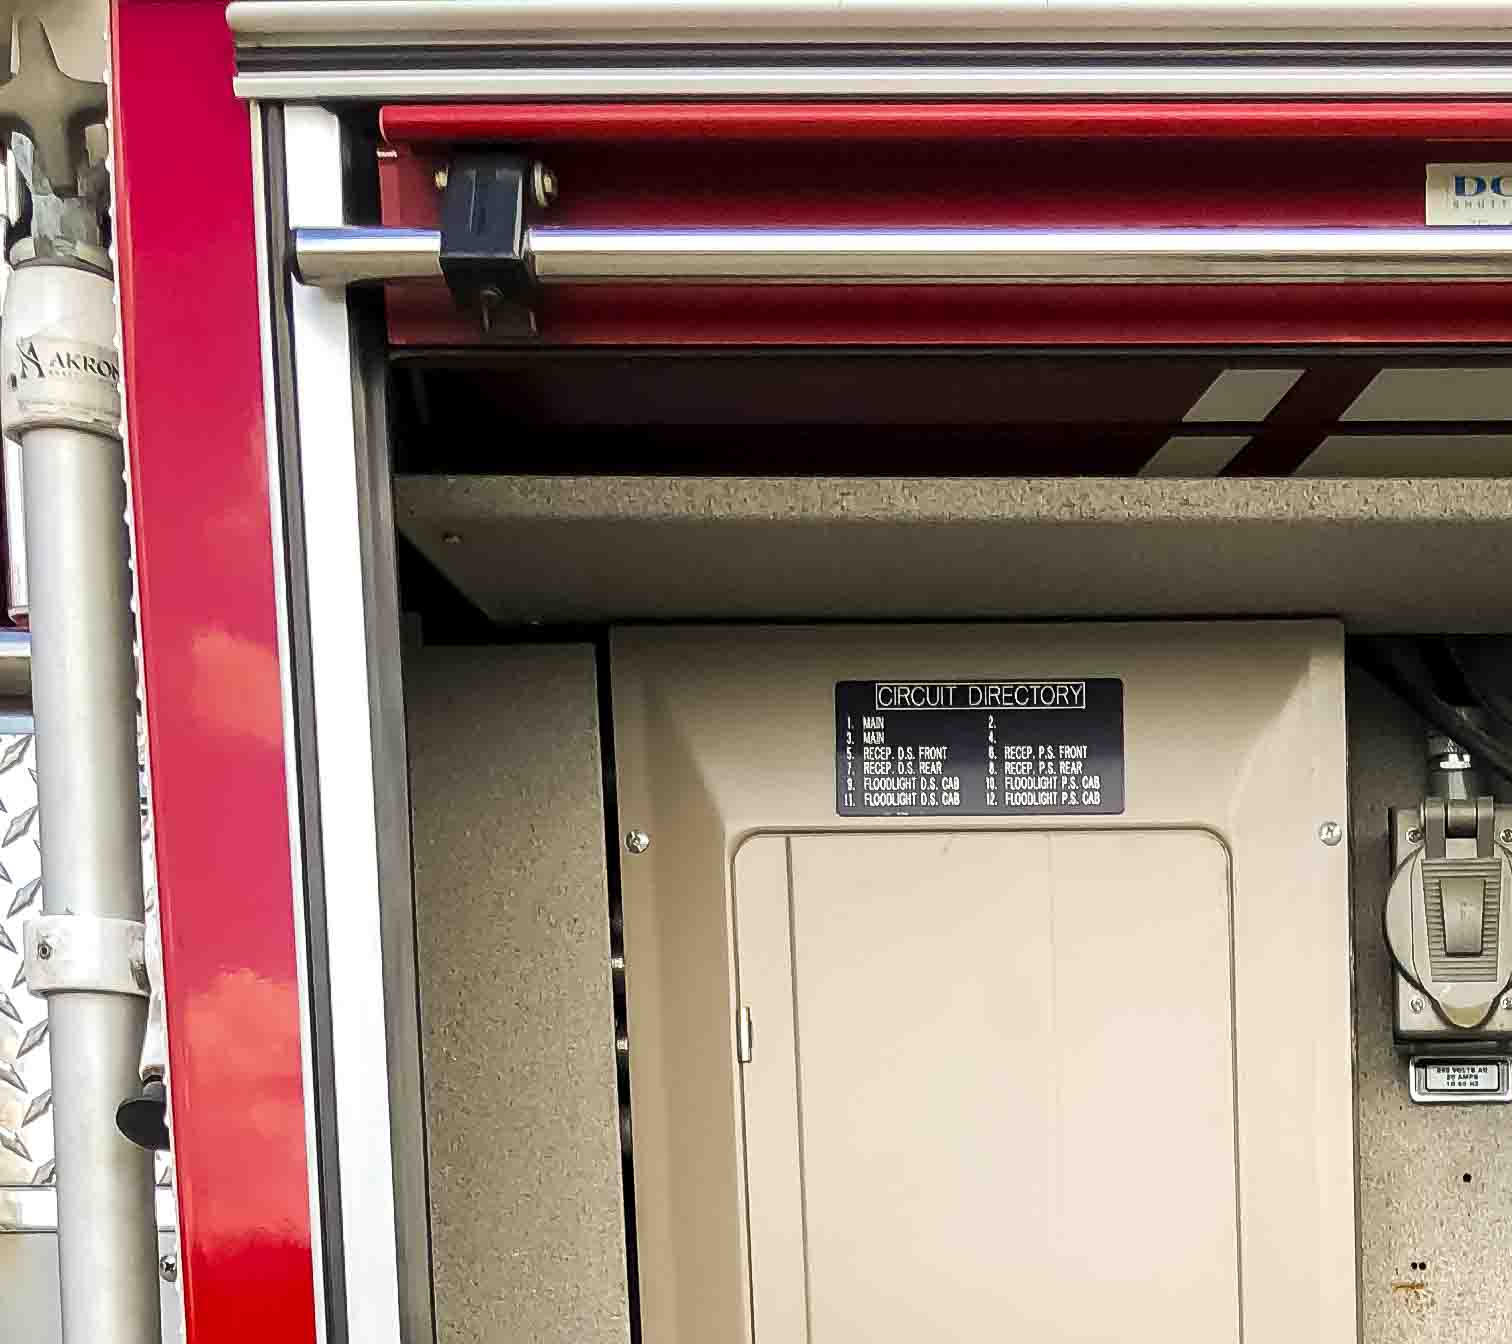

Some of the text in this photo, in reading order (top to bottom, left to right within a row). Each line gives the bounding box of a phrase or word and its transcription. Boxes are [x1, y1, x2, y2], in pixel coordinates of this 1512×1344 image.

[878, 685, 1084, 706] CIRCUIT DIRECTORY
[862, 716, 884, 730] MAIN
[988, 716, 997, 729] 2.
[846, 731, 885, 745] 3. MAIN
[863, 746, 895, 760] RECEP.
[918, 746, 948, 760] FRONT
[1004, 746, 1036, 760] RECEP.
[1038, 746, 1056, 760] P.S.
[1059, 746, 1088, 760] FRONT
[863, 761, 895, 775] RECEP.
[898, 761, 916, 775] D.S.
[919, 761, 943, 775] REAR
[1004, 761, 1036, 775] RECEP.
[1038, 761, 1056, 775] P.S.
[1059, 761, 1083, 775] REAR
[864, 777, 917, 791] FLOODLIGHT
[920, 776, 939, 790] D.S.
[941, 776, 960, 790] CAB
[1004, 776, 1058, 790] FLOODLIGHT
[1061, 776, 1079, 790] P.S.
[1082, 776, 1100, 790] CAB
[864, 792, 917, 807] FLOODLIGHT
[920, 792, 939, 806] D.S.
[941, 792, 960, 806] CAB
[986, 791, 1100, 806] 12. FLOODLIGHT P.S. CAB
